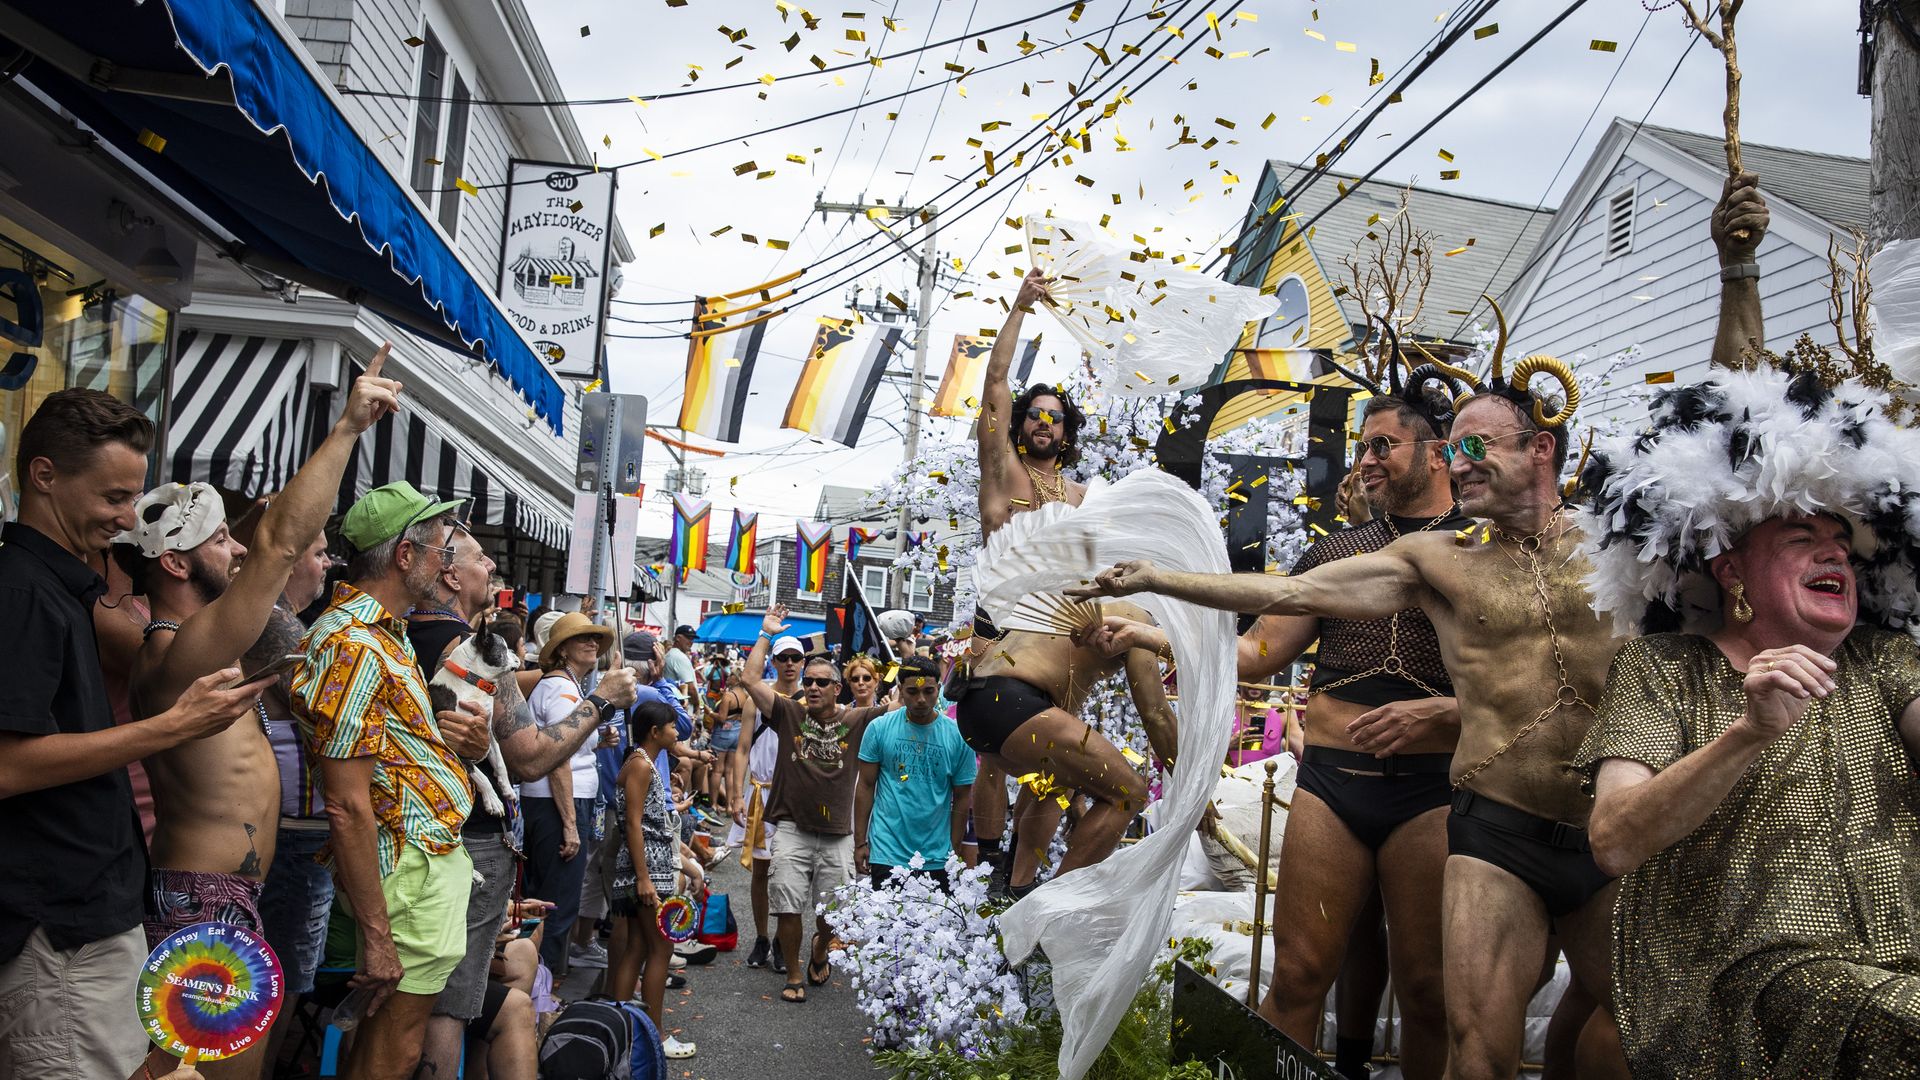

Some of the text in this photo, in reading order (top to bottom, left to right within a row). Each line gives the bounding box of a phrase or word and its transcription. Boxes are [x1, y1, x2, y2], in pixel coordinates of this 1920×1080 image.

[546, 197, 573, 209] THE
[510, 211, 604, 242] MAYFLOWER
[540, 324, 548, 335] &
[552, 315, 595, 336] DRINK
[149, 927, 279, 998] Shop Stay Eat Play Live Love
[165, 972, 260, 1002] SEAMEN'S BANK
[181, 992, 238, 1008] seamensbank.com
[142, 986, 273, 1057] Shop Stay Eat Play Live Love
